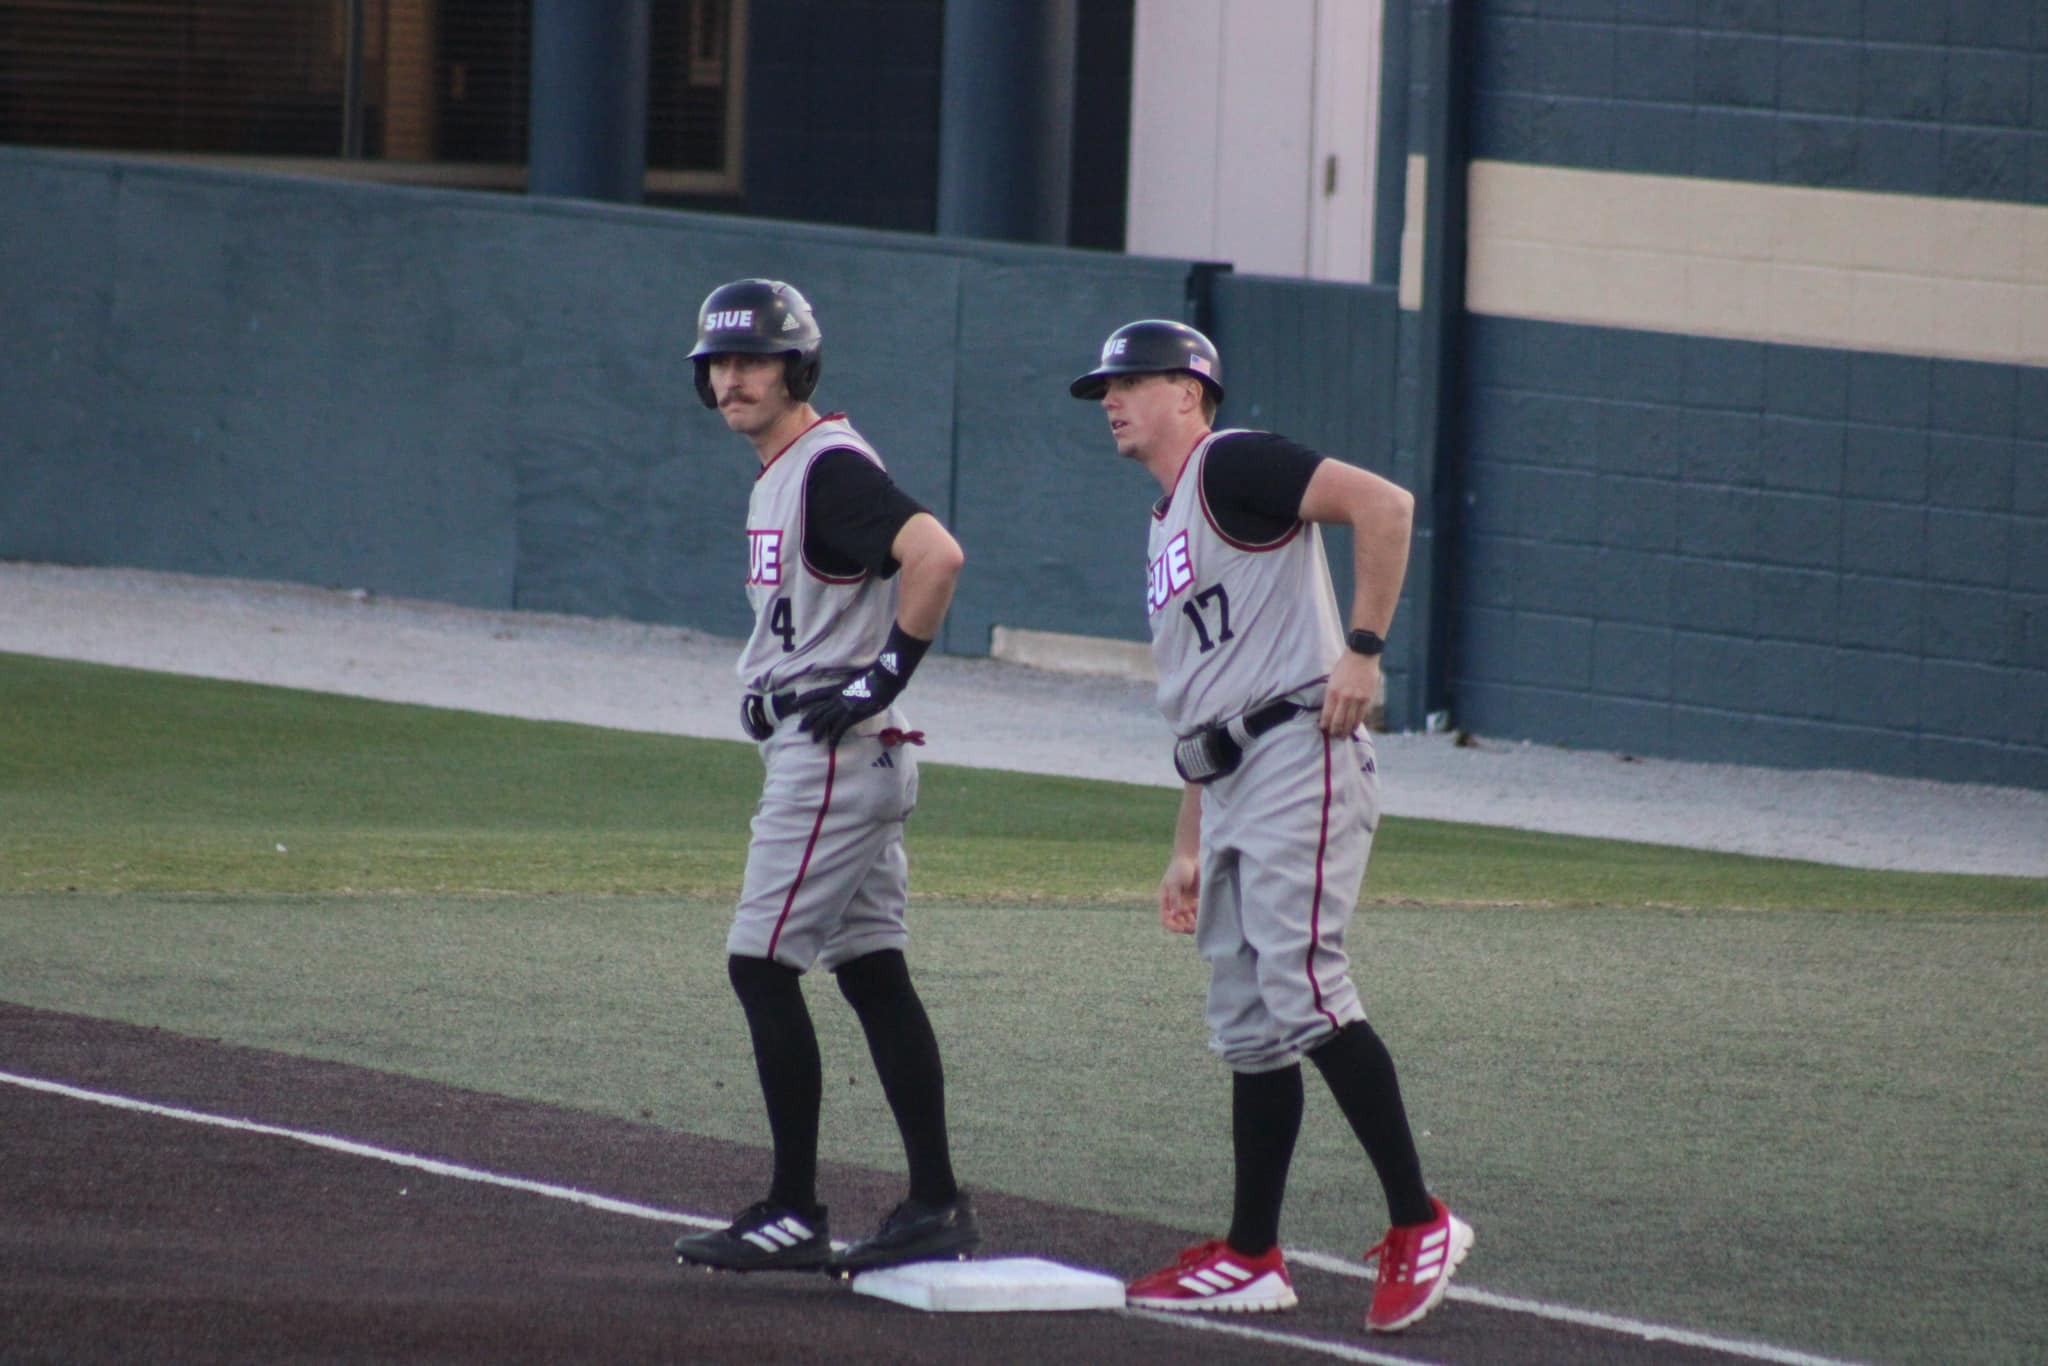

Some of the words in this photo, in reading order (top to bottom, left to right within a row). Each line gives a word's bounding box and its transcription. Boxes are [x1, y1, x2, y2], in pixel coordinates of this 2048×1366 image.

[705, 310, 752, 331] SIUE
[771, 597, 795, 653] 4
[1183, 582, 1234, 654] 17
